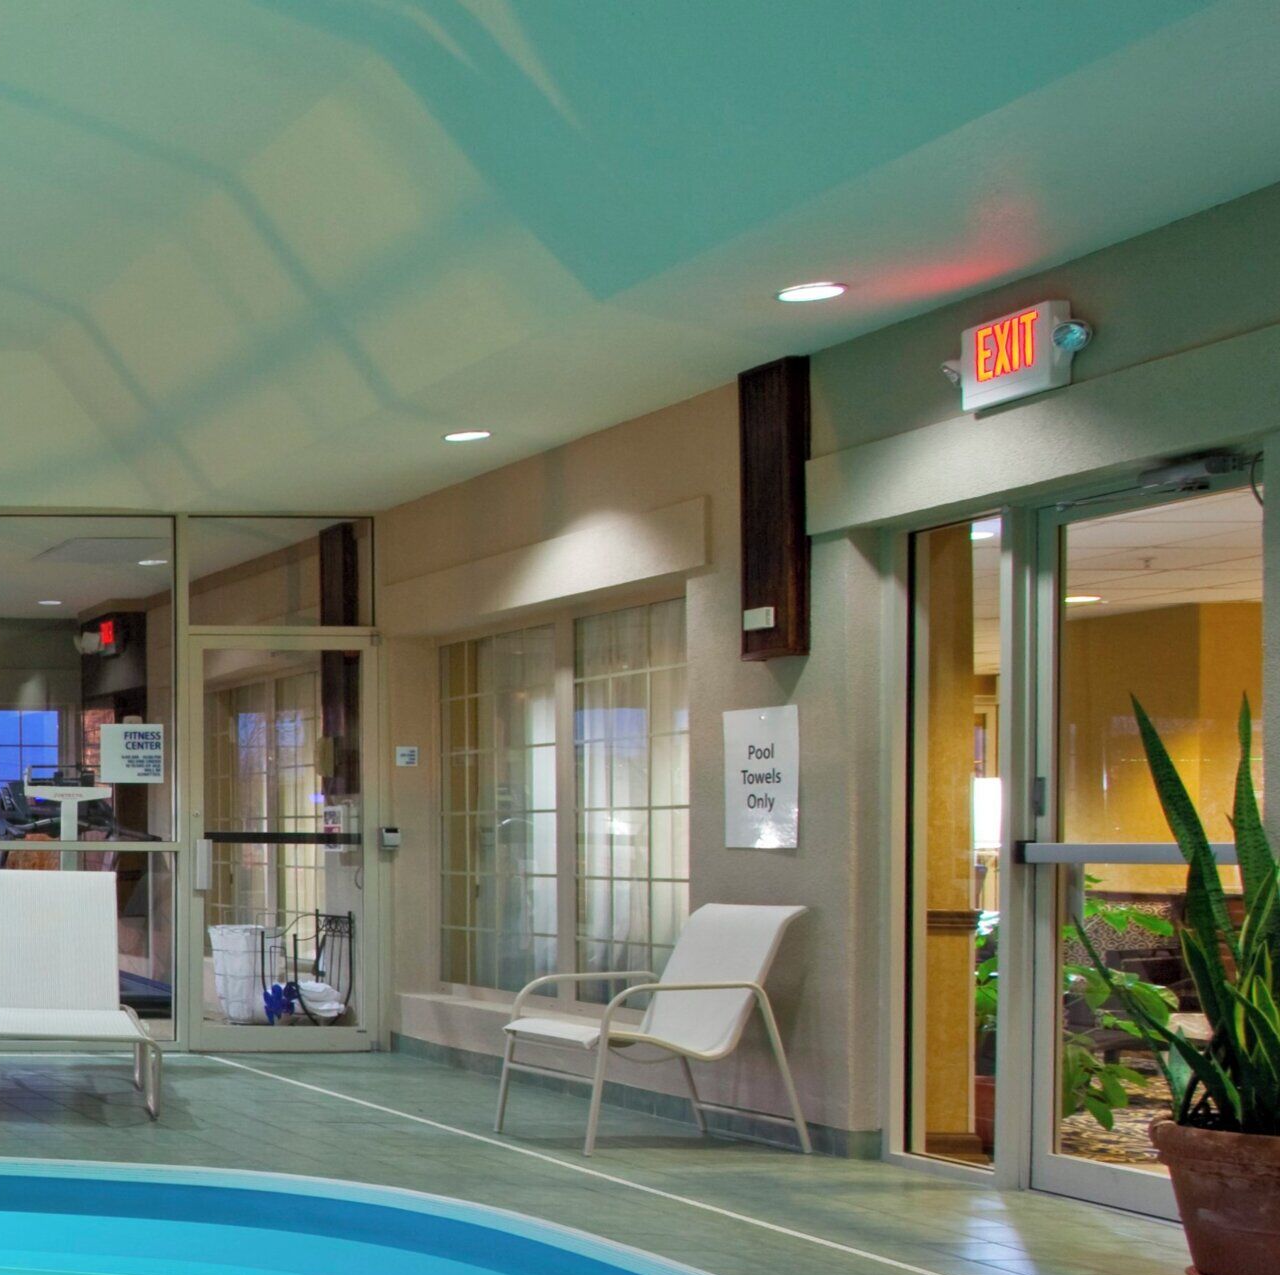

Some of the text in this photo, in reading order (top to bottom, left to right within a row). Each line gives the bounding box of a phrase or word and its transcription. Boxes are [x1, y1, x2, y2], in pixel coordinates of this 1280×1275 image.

[976, 310, 1038, 382] EXIT
[124, 731, 161, 740] FITNESS
[125, 741, 161, 750] CENTER
[748, 743, 774, 760] Pool
[741, 768, 781, 785] Towels
[747, 793, 775, 812] Only
